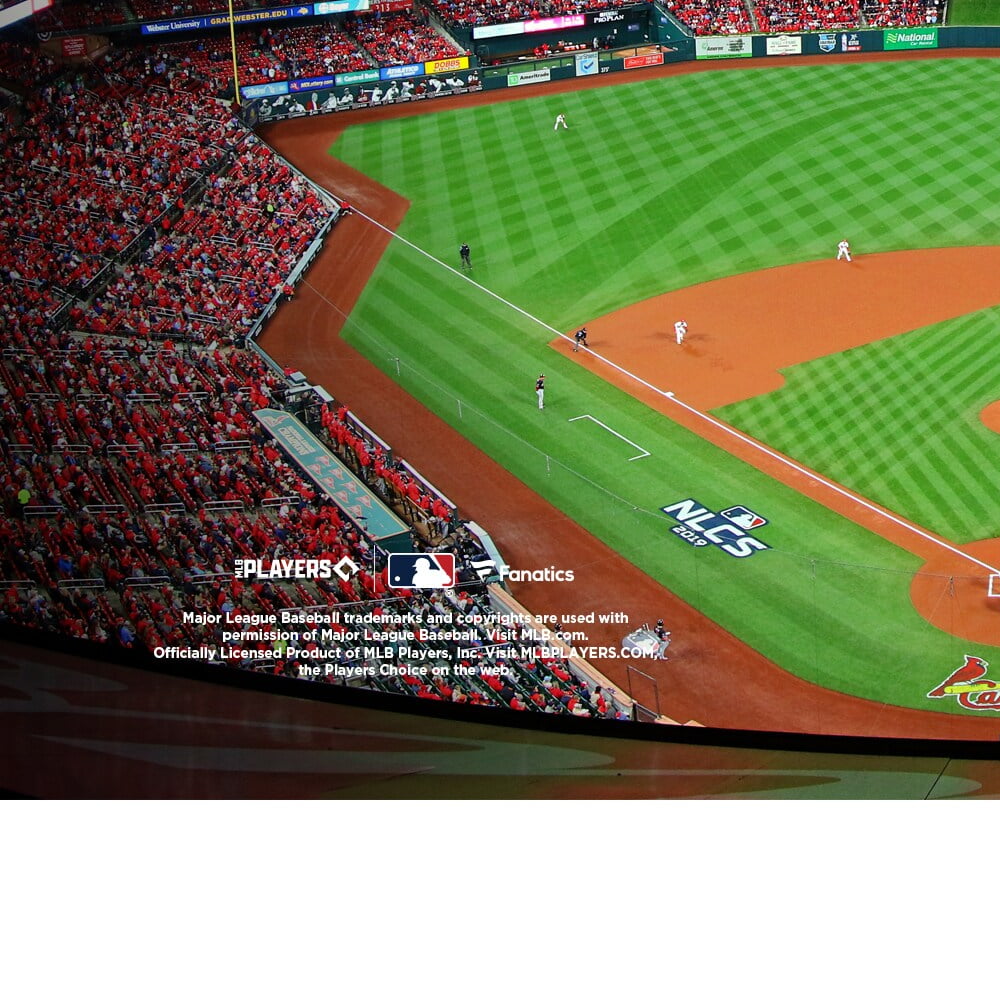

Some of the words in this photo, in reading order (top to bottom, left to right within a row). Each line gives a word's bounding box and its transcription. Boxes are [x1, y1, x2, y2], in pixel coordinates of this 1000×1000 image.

[147, 23, 170, 33] Webster
[171, 19, 200, 31] University
[210, 9, 288, 26] GRADWEBSTER.EDU
[897, 32, 935, 42] National
[434, 60, 460, 69] DOBBS
[519, 71, 550, 81] Ameritrade
[663, 499, 769, 557] NLCS
[672, 525, 708, 546] 2019
